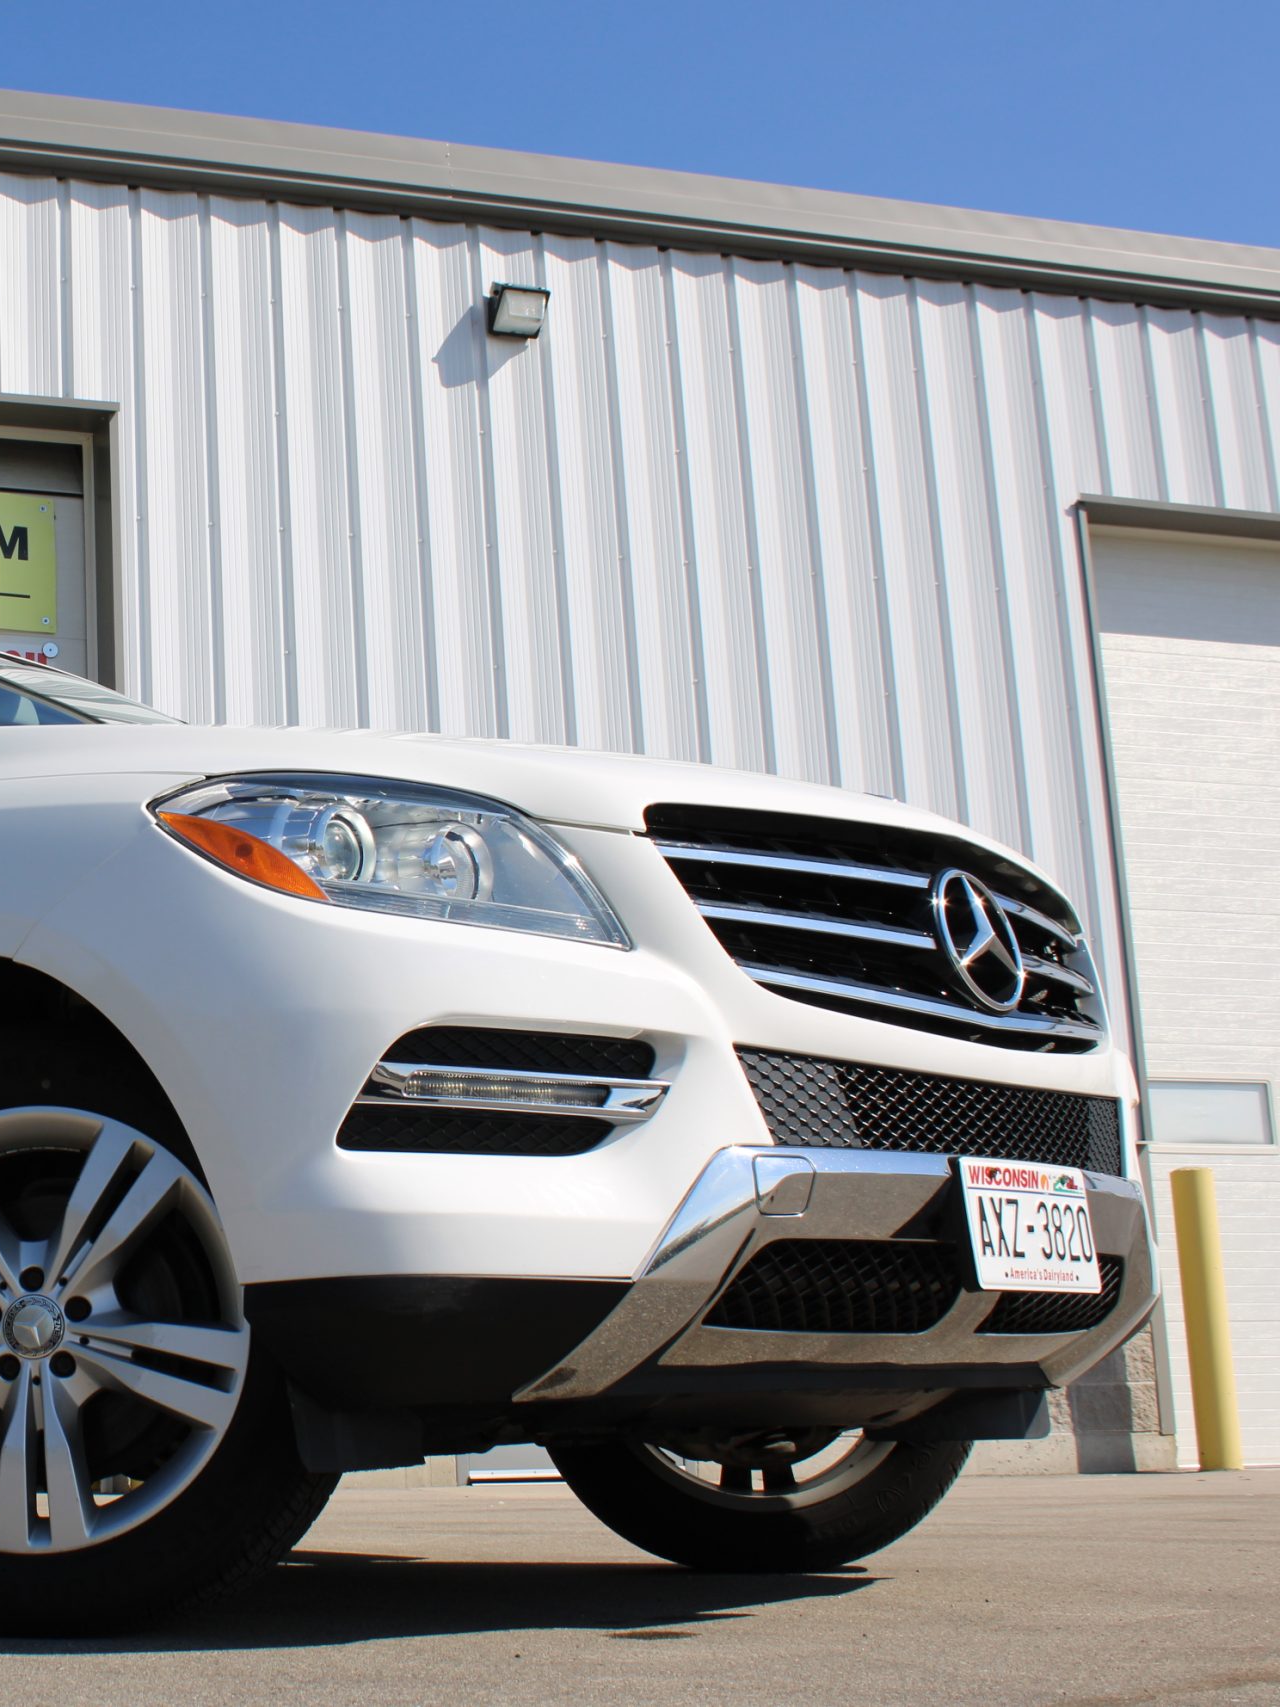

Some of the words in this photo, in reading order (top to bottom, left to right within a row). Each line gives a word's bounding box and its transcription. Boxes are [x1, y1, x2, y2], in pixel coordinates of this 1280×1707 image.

[968, 1165, 1039, 1189] WISCONSIN
[978, 1196, 1093, 1263] AXZ-3820
[1010, 1267, 1042, 1280] America's
[1043, 1269, 1074, 1284] Dairyland
